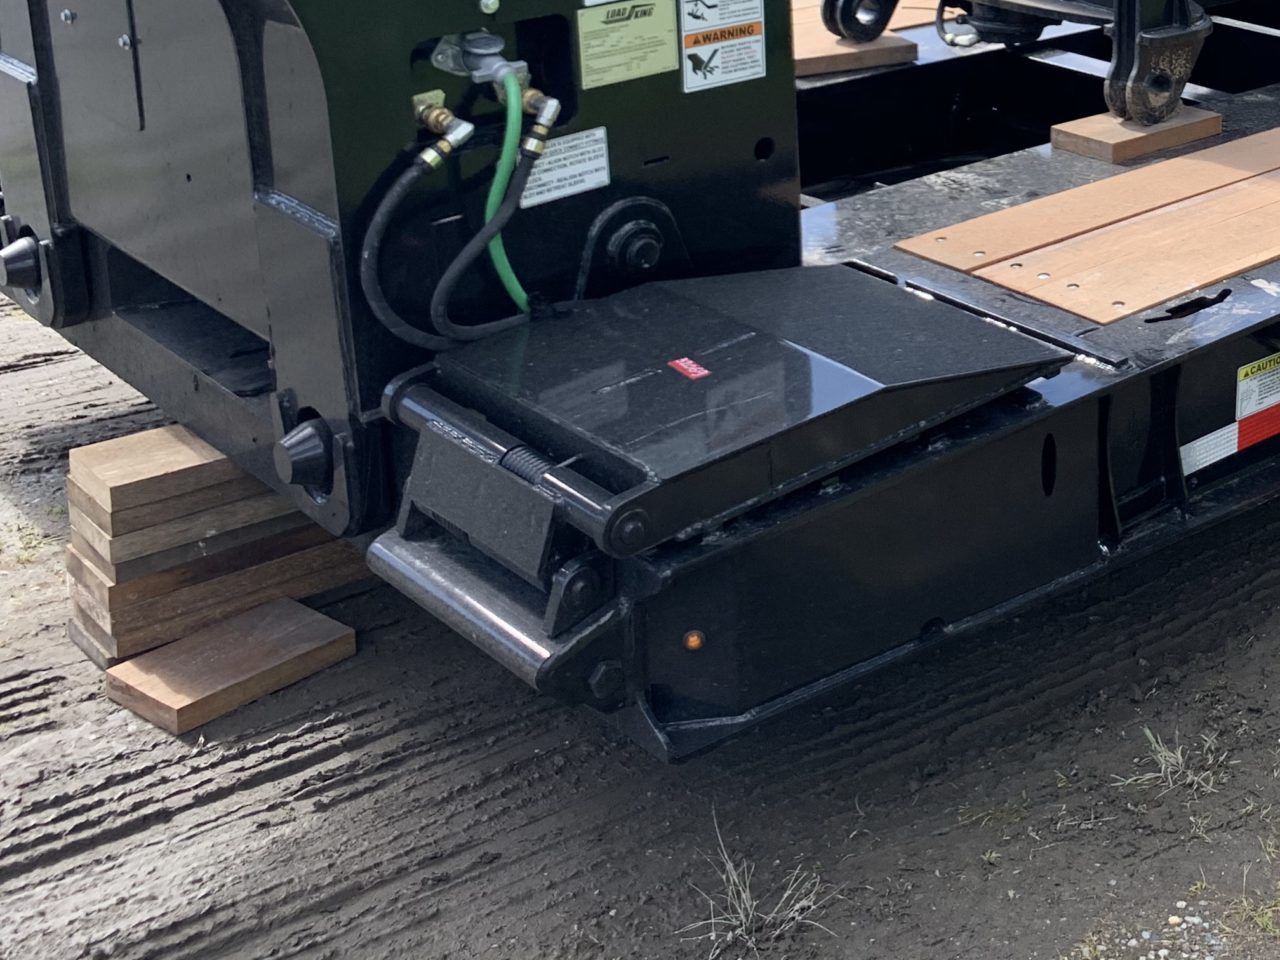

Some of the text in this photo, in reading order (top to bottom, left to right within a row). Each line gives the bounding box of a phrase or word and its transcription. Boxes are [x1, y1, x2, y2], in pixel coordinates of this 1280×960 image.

[606, 7, 654, 19] LOAD KING
[702, 25, 754, 43] WARNING
